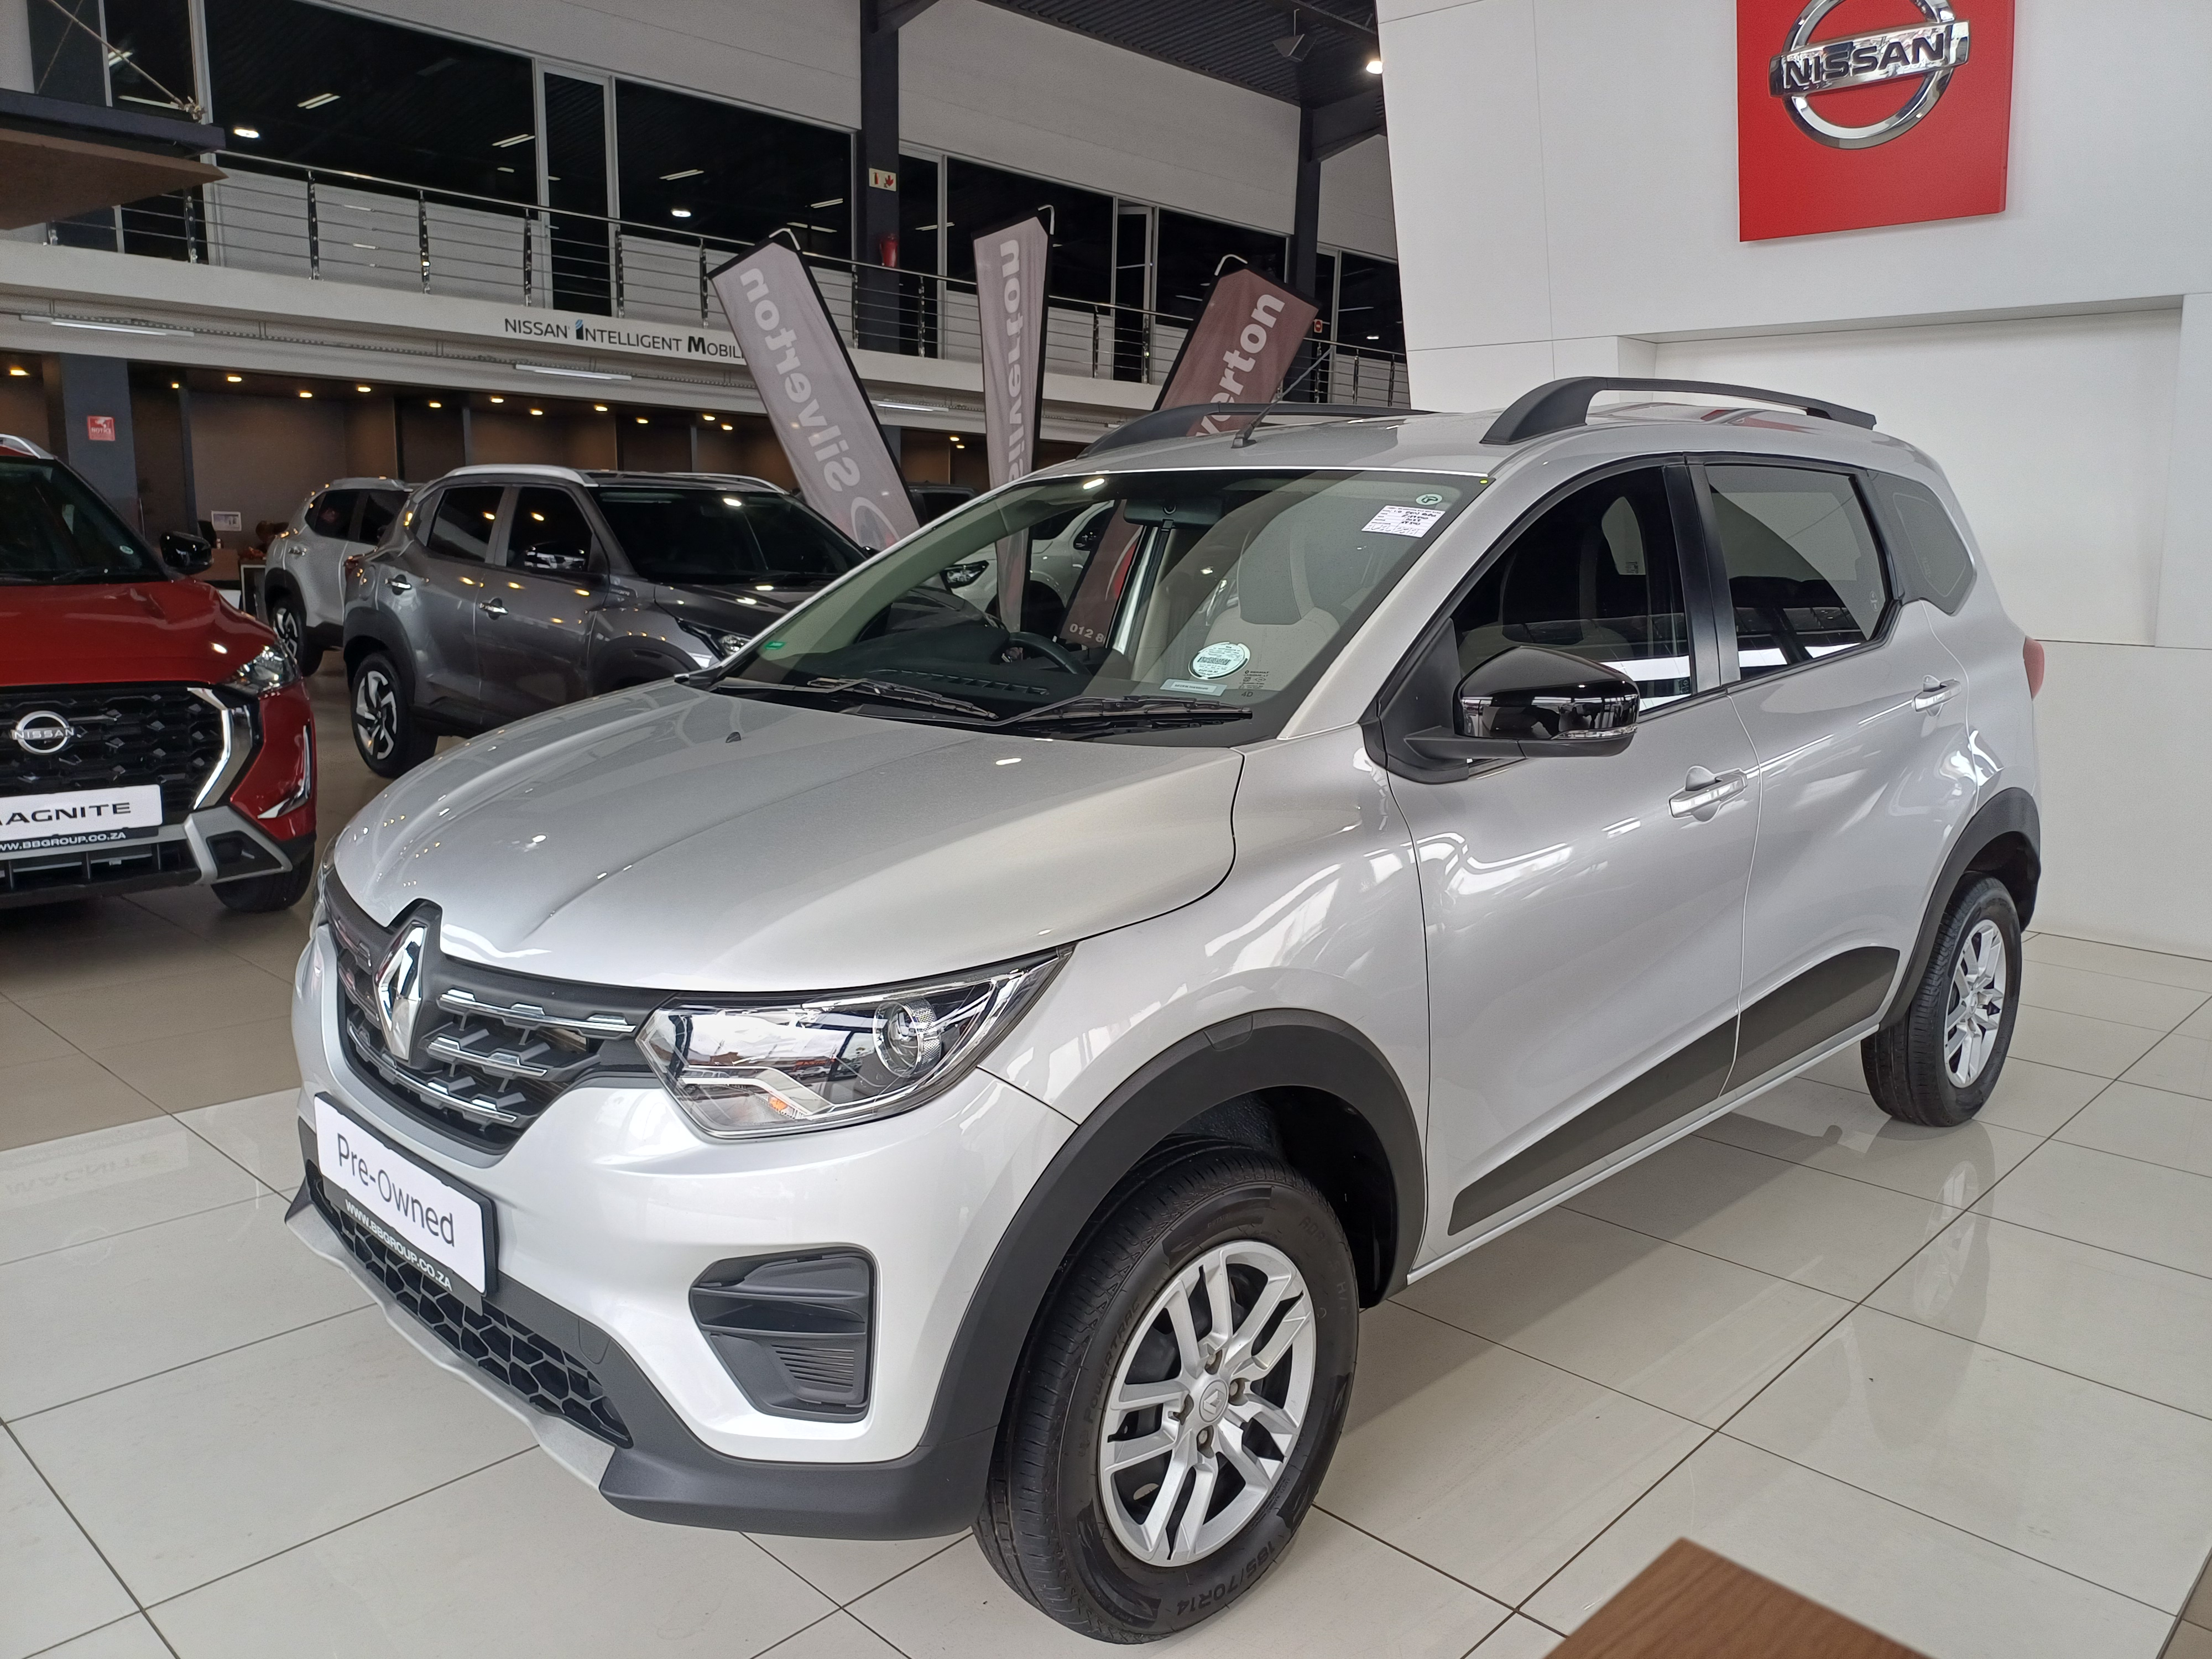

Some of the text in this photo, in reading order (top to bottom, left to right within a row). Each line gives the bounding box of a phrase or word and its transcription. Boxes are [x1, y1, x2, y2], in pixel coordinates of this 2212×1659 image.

[1783, 32, 1945, 89] NISSAN
[504, 318, 568, 339] NISSAN
[1070, 623, 1094, 639] 012
[14, 727, 75, 739] NISSAN
[0, 802, 131, 826] AGNITE
[337, 1133, 455, 1248] Pre-Owned
[345, 1198, 453, 1292] WWW.BBGROUP.CO.ZA
[1177, 1541, 1275, 1616] 185/70R14
